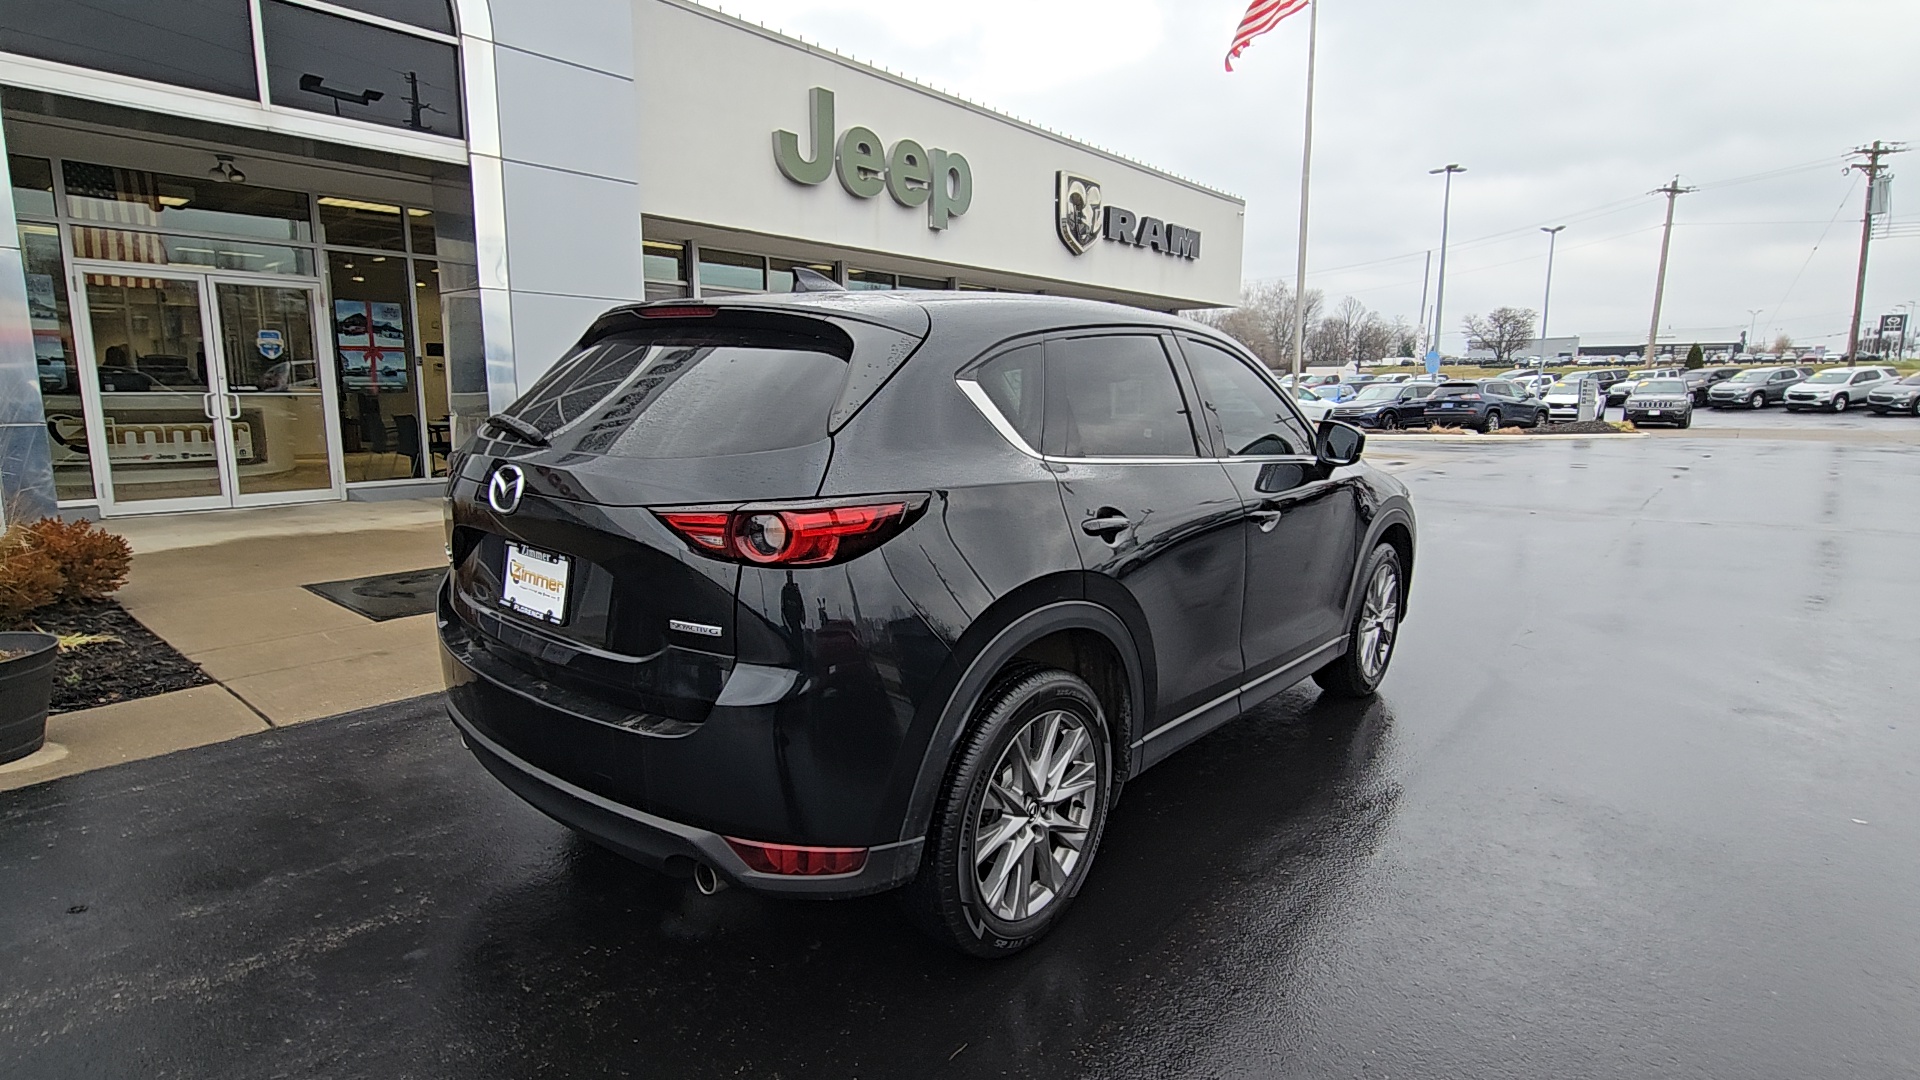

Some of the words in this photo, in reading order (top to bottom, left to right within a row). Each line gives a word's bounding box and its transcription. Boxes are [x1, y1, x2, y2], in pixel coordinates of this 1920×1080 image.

[772, 87, 972, 230] Jeep
[1103, 205, 1201, 259] RAM
[521, 544, 552, 562] Zimmer
[511, 560, 564, 593] Zimmer
